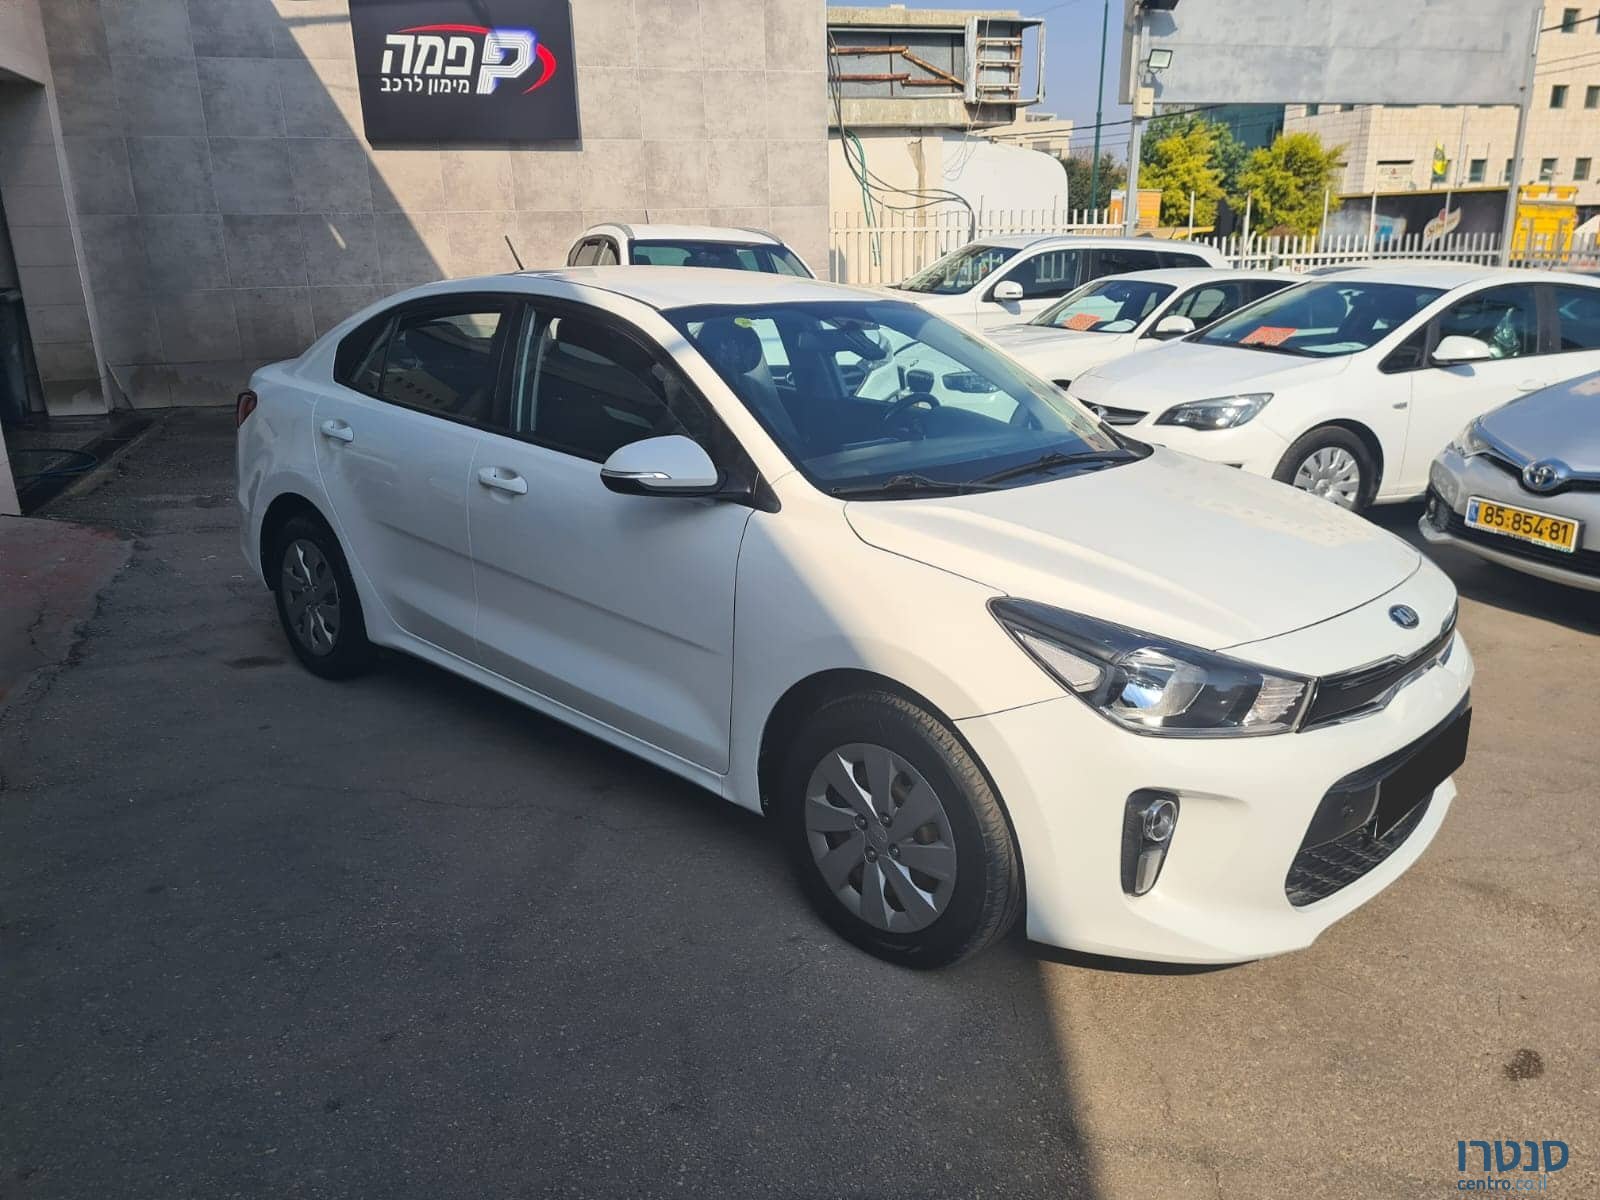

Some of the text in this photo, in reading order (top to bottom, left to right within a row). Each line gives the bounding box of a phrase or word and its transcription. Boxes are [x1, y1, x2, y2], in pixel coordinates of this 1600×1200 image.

[381, 34, 475, 76] פמה
[380, 75, 470, 96] מימון לרכב
